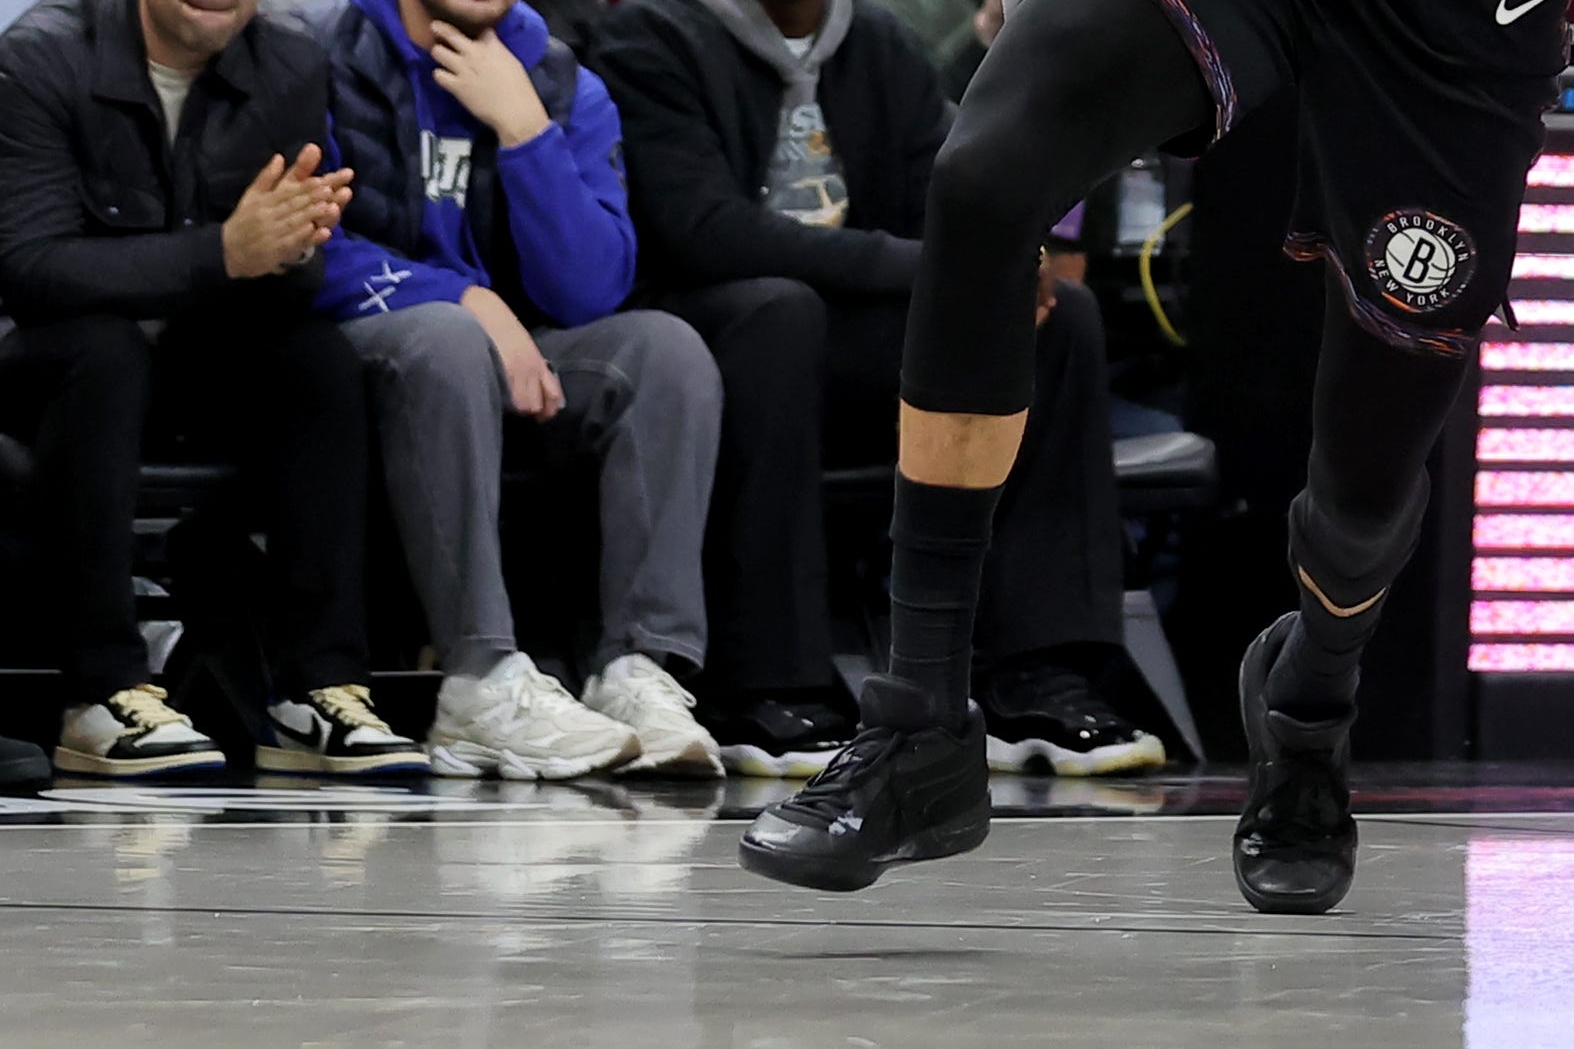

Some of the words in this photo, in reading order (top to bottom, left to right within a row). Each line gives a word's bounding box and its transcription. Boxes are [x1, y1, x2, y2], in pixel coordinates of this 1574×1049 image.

[1386, 215, 1470, 263] BROOKLYN
[1373, 258, 1400, 293] NEW
[1403, 236, 1436, 284] B
[1405, 287, 1451, 306] YORK
